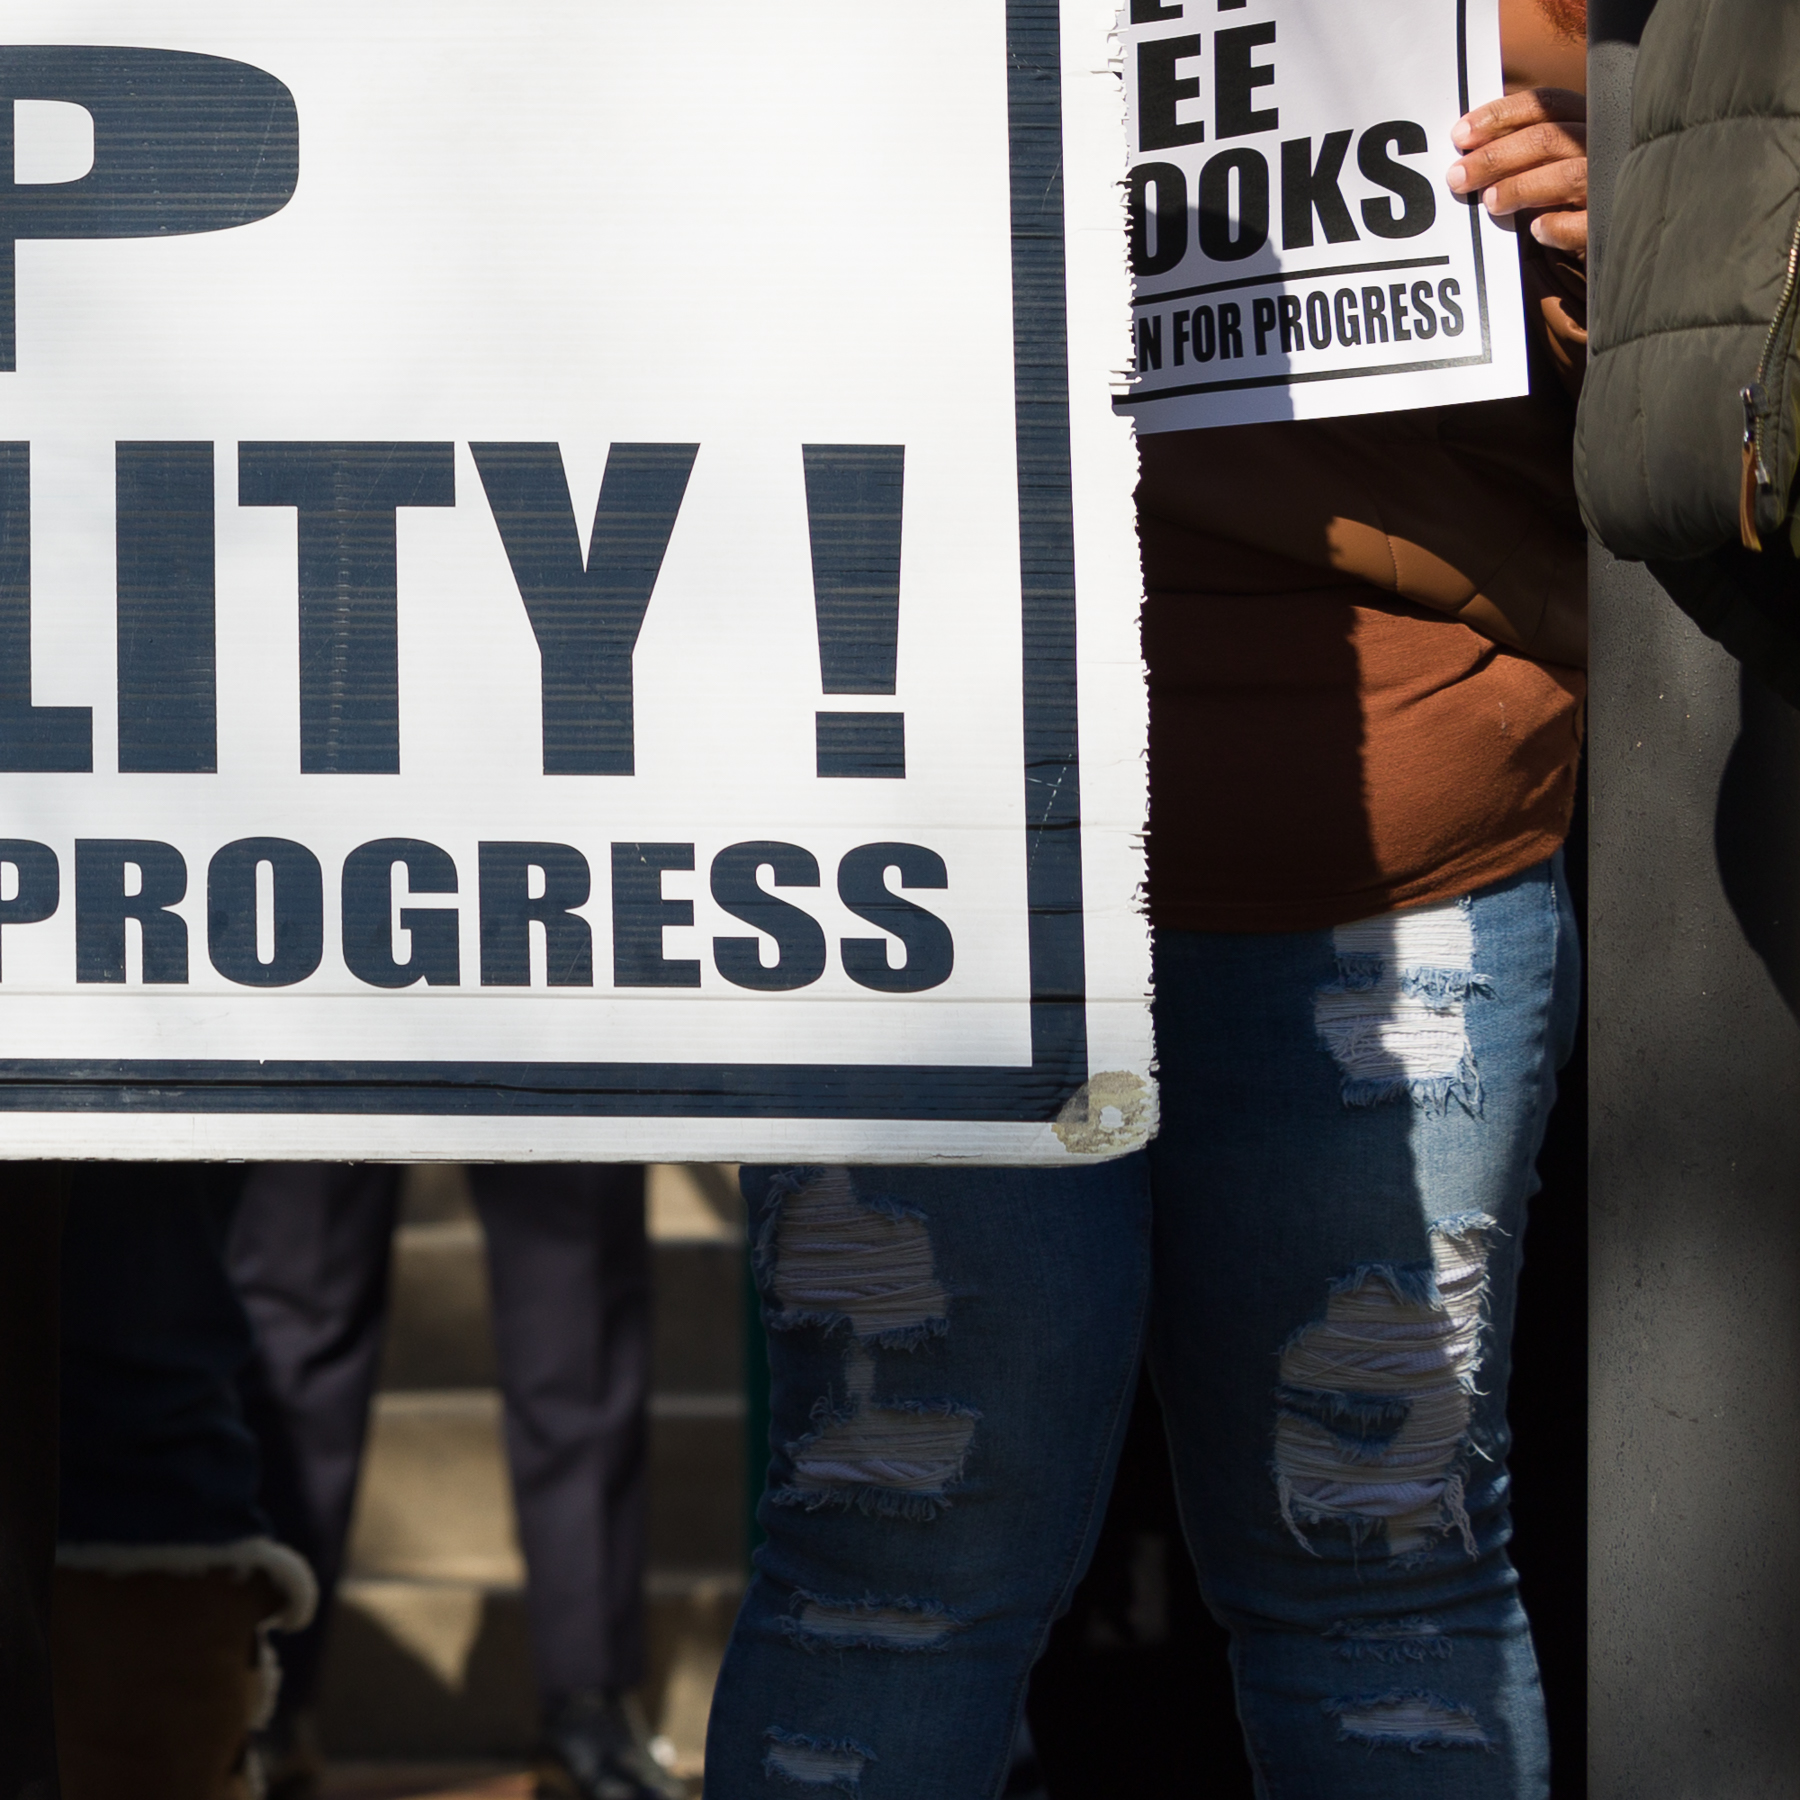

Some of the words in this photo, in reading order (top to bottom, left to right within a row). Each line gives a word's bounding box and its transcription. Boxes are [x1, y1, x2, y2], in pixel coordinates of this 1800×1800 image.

[1137, 21, 1279, 152] EE
[1129, 120, 1436, 276] OOKS
[1173, 302, 1244, 368] FOR
[1252, 278, 1464, 356] PROGRESS
